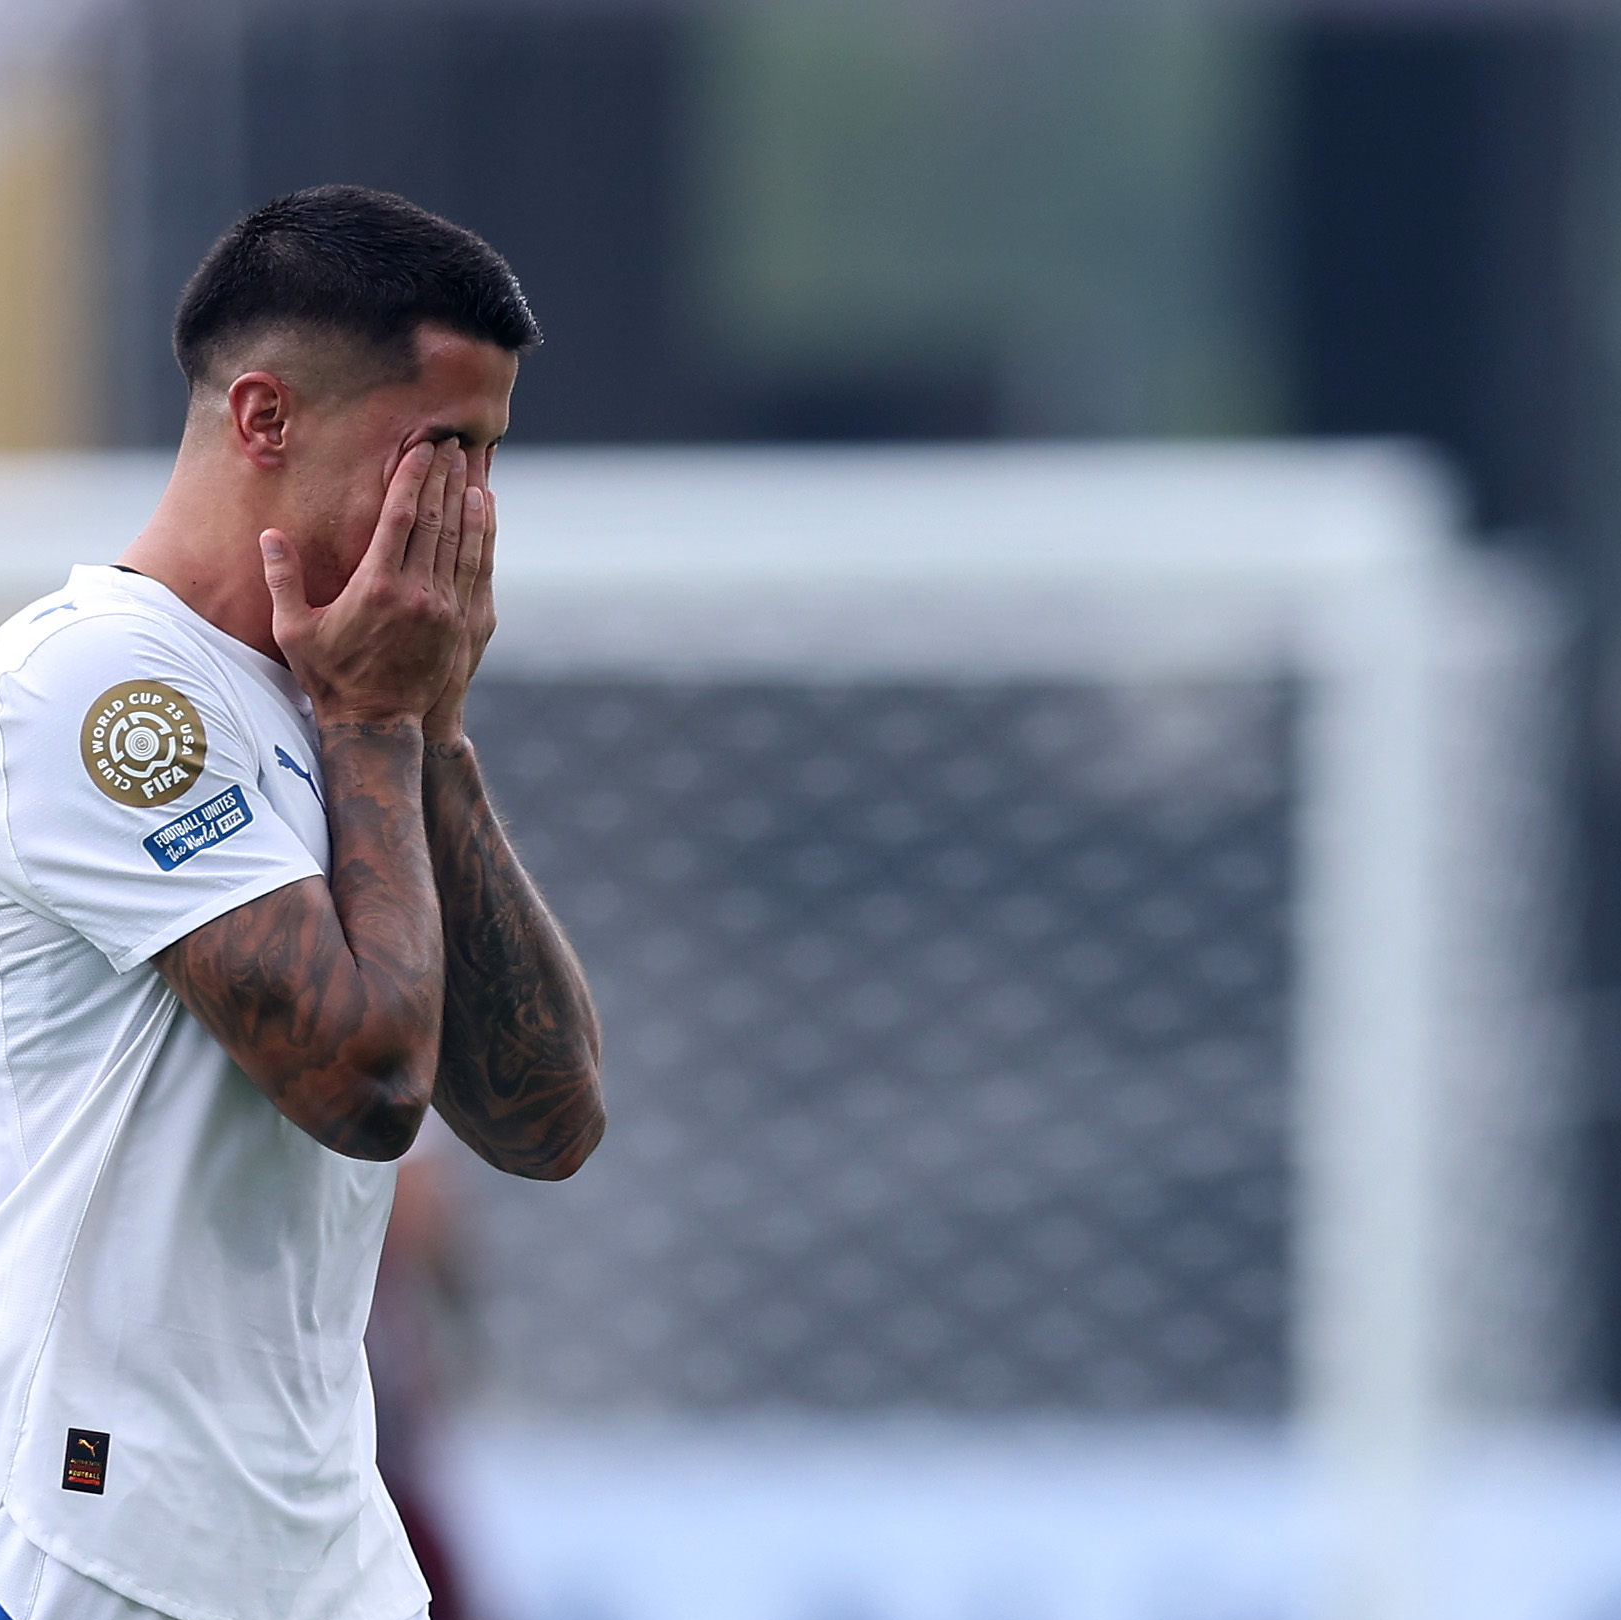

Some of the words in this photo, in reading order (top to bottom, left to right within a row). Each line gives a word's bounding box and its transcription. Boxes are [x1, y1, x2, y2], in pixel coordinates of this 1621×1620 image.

[128, 692, 163, 705] CUP
[164, 702, 185, 721] 25
[91, 699, 125, 754] WORLD
[180, 723, 194, 756] USA
[96, 758, 131, 790] CLUB
[140, 765, 190, 799] FIFA
[153, 813, 204, 849] FOOTBALL
[200, 792, 237, 821] UNITES
[220, 812, 242, 830] FIFA
[164, 844, 187, 862] the
[181, 821, 219, 850] World
